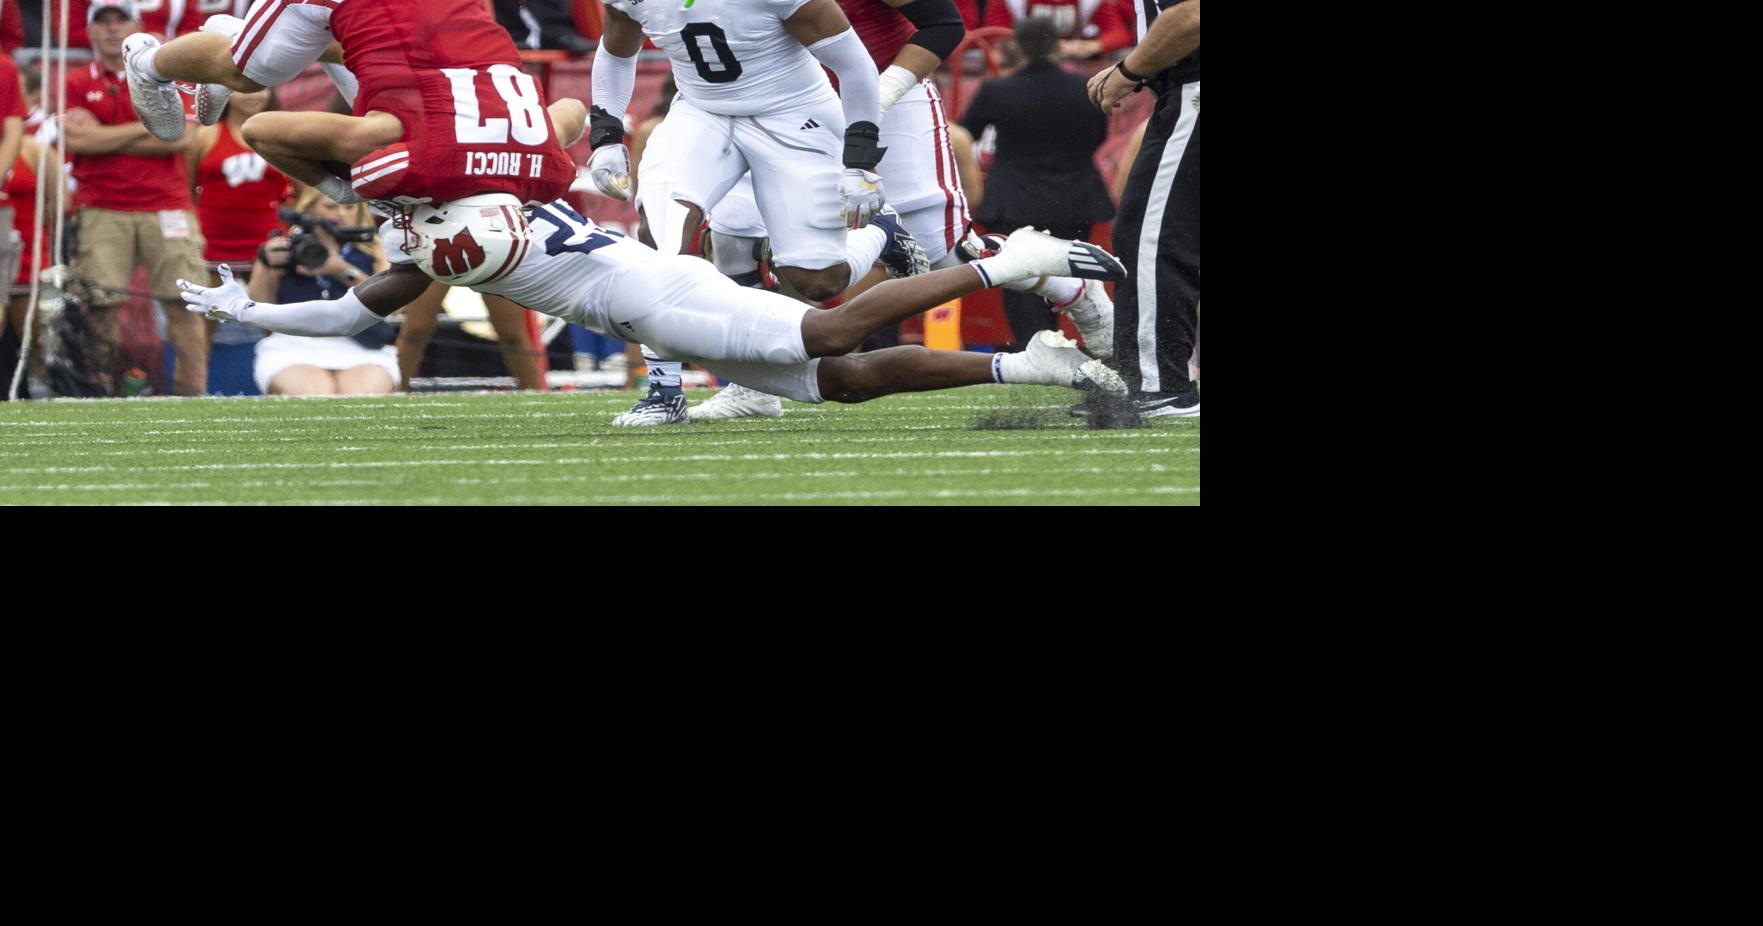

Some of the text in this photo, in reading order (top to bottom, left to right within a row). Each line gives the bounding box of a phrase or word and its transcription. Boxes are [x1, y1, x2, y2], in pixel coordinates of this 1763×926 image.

[680, 22, 743, 83] 0
[439, 63, 548, 146] 87
[464, 151, 544, 177] H. RUCCI
[432, 226, 486, 276] W
